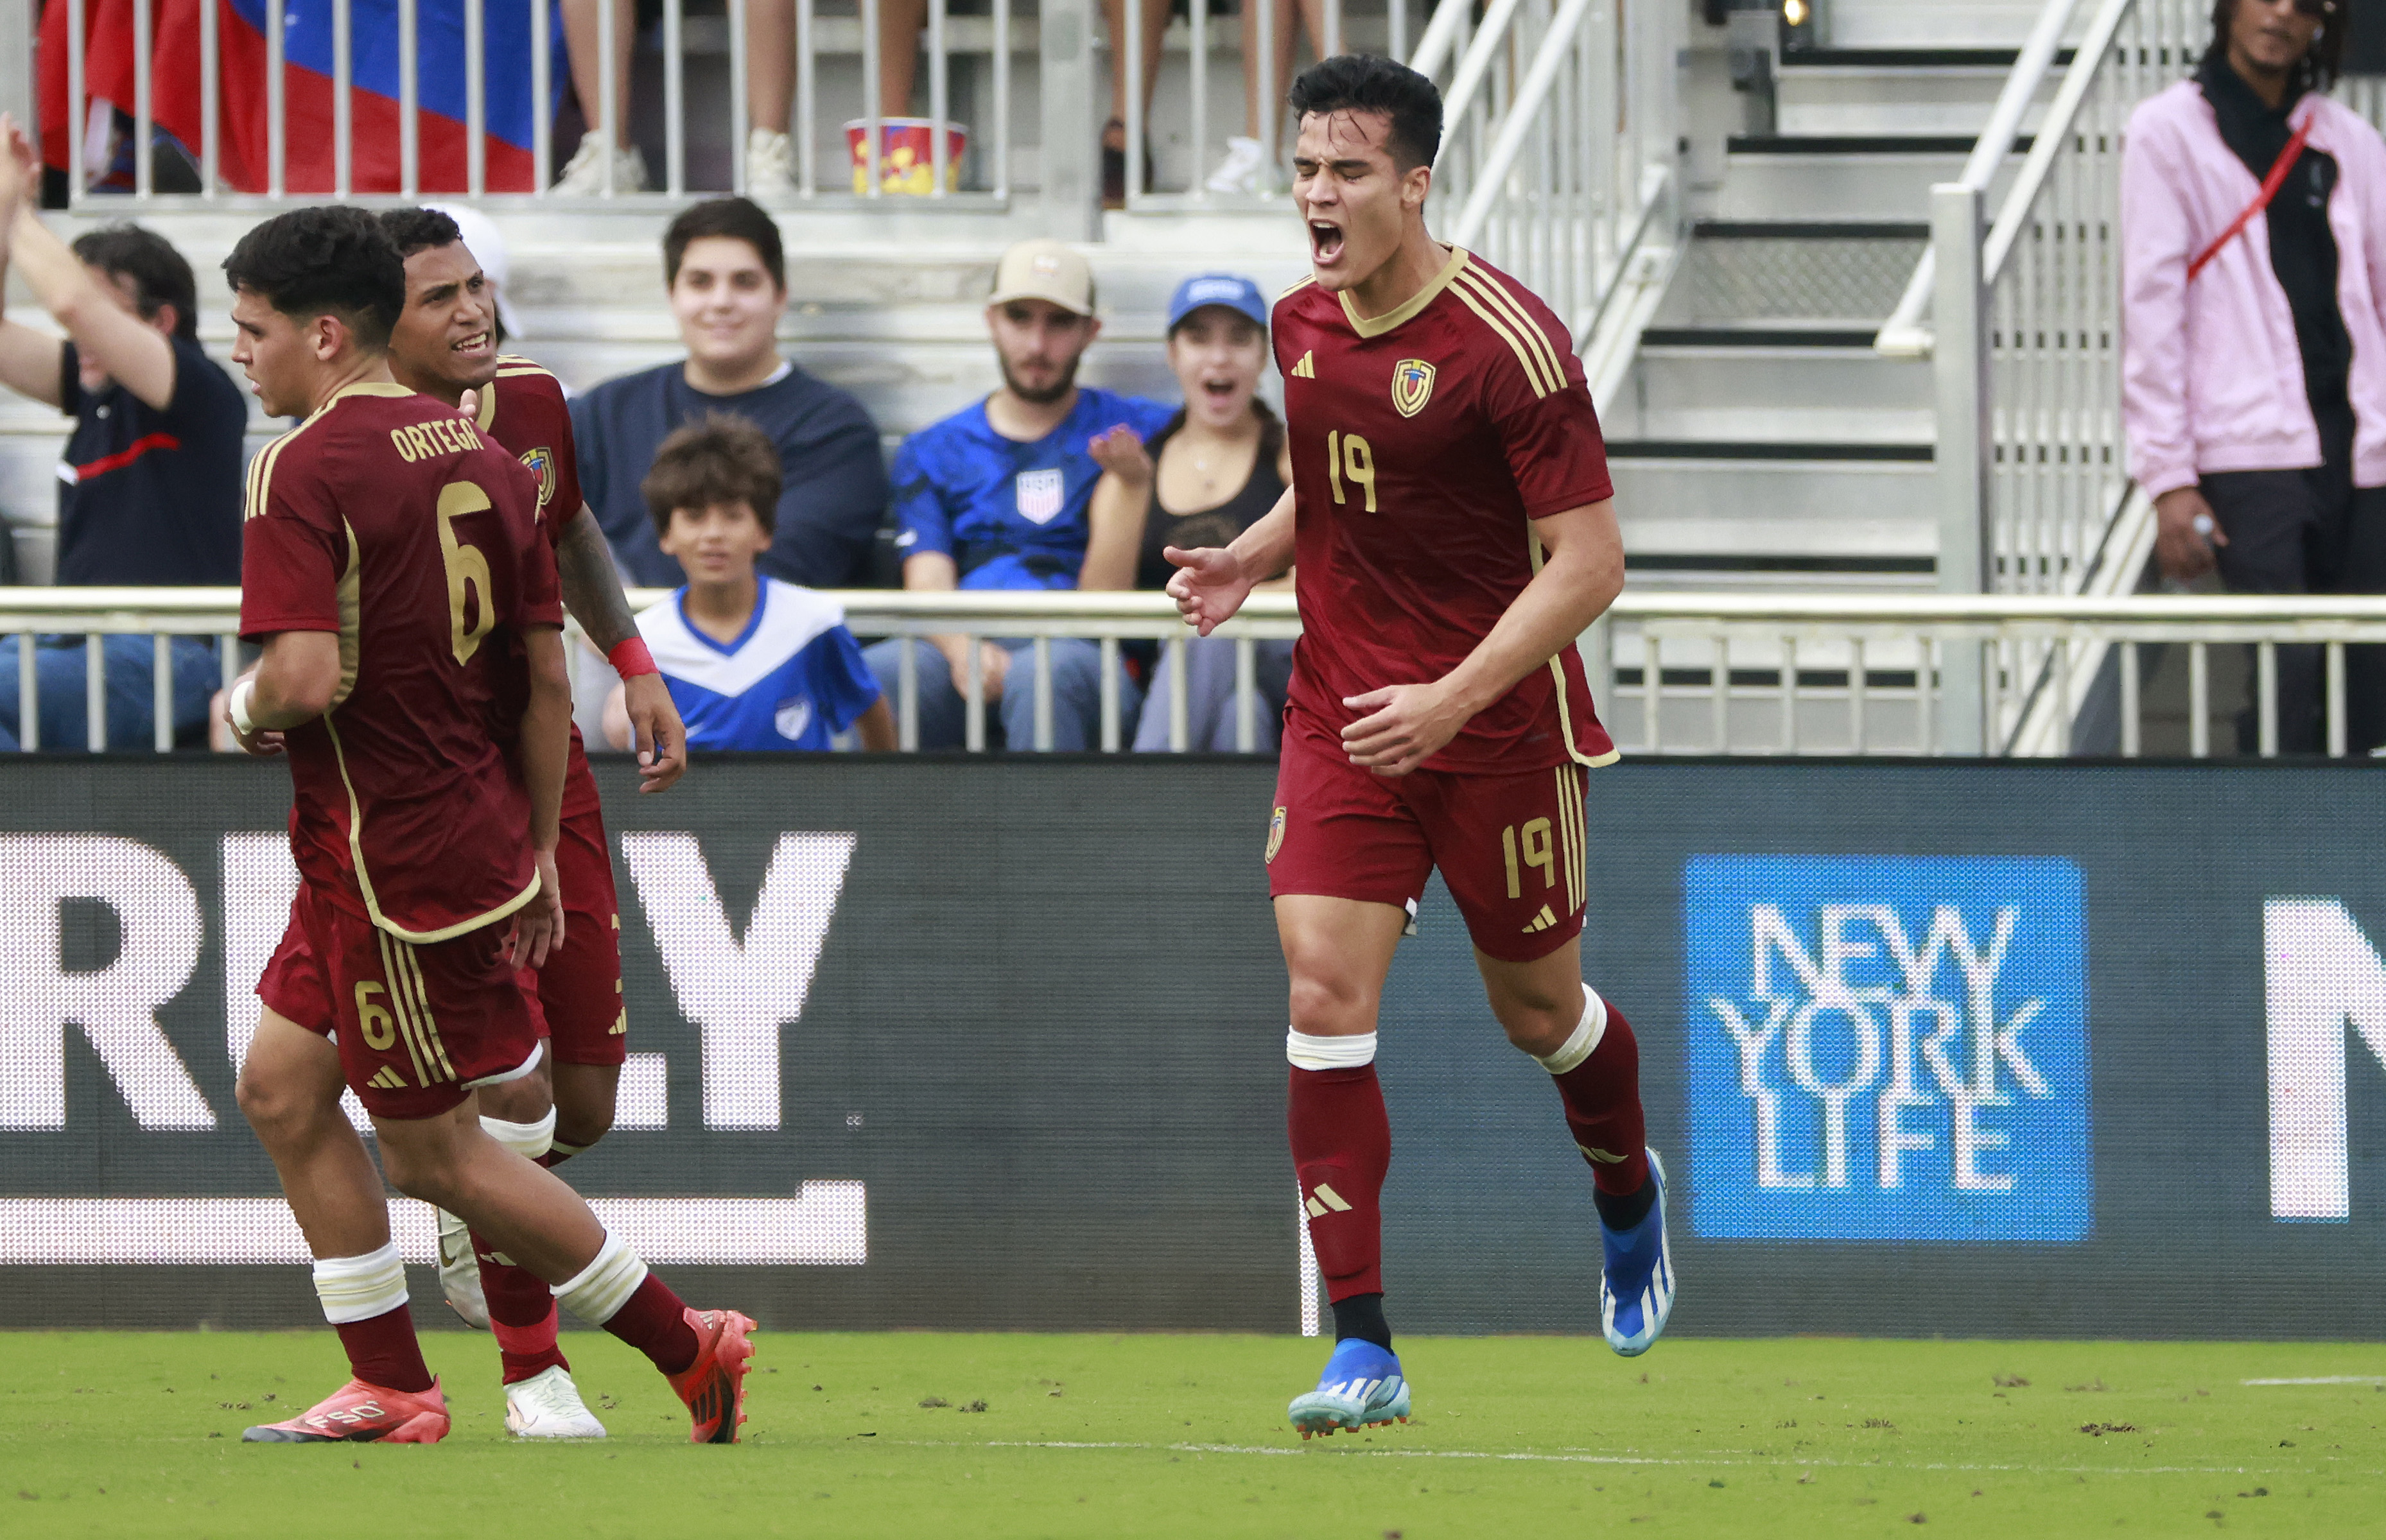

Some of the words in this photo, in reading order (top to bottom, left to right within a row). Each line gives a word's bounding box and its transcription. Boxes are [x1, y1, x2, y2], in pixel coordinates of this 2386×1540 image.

[390, 419, 484, 463] ORTEGA
[1328, 429, 1377, 513] 19
[437, 481, 495, 667] 6
[1502, 817, 1555, 899] 19
[1751, 902, 2023, 1009] NEW
[355, 980, 396, 1051] 6
[1705, 995, 2053, 1101] YORK
[1754, 1089, 2014, 1195] LIFE
